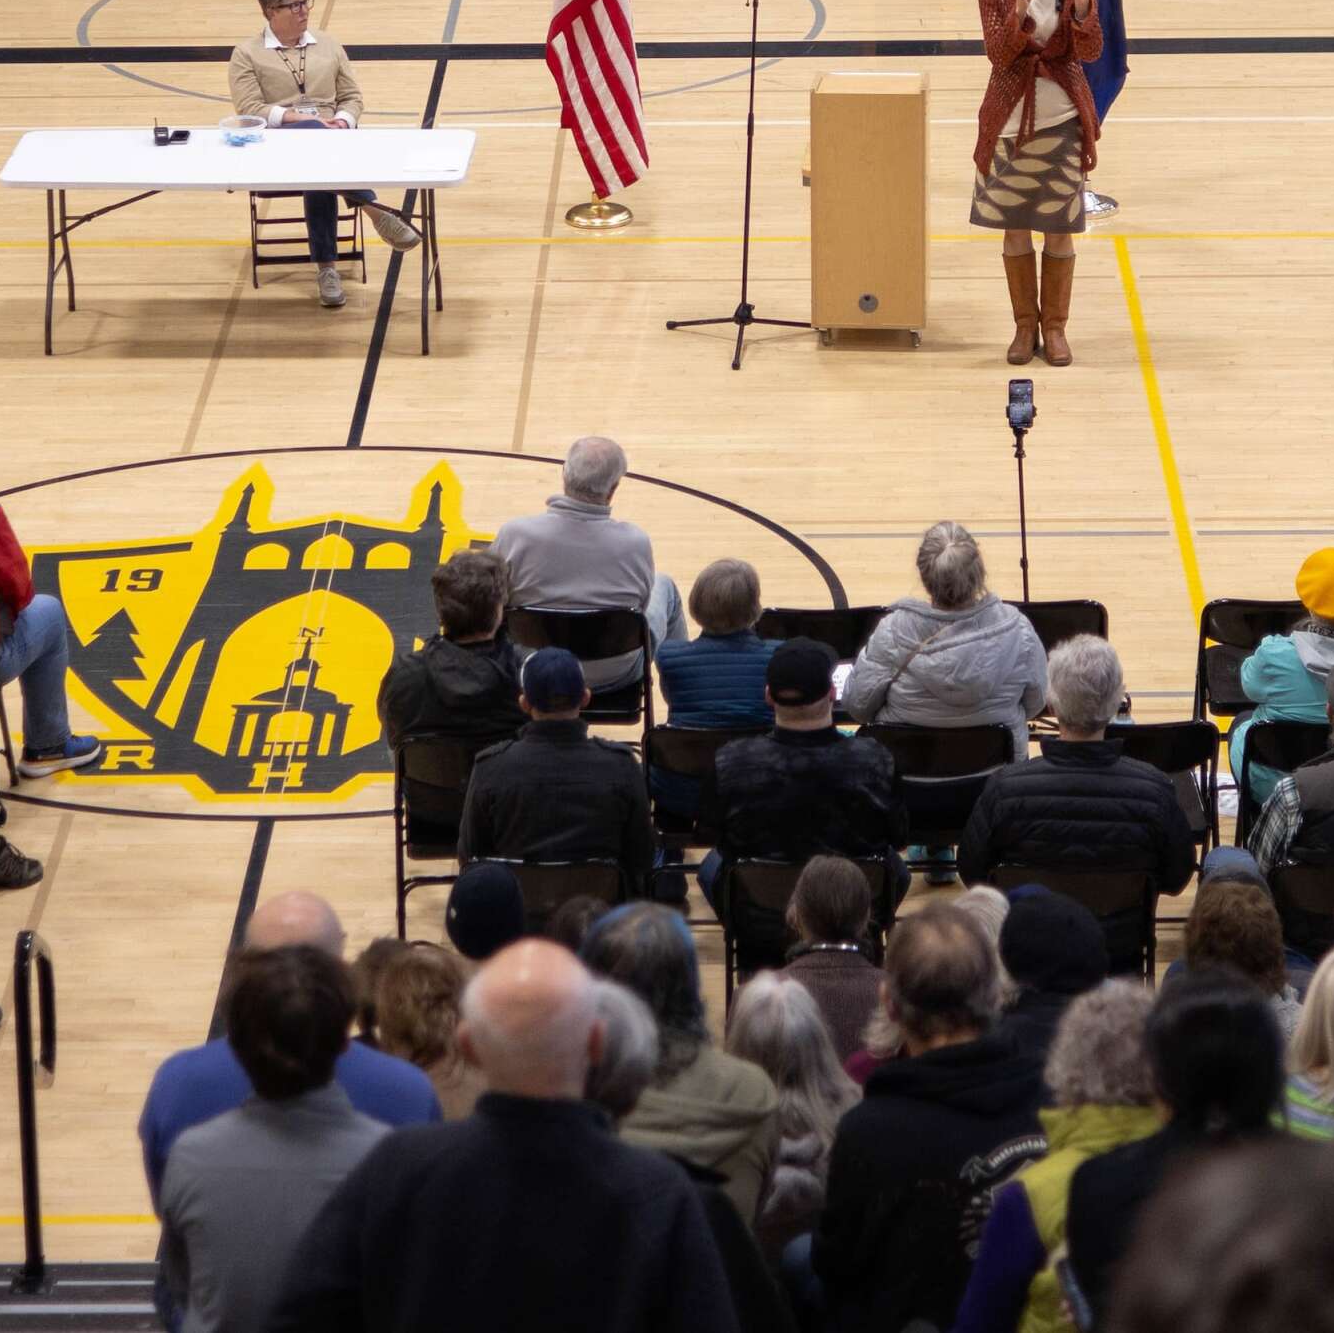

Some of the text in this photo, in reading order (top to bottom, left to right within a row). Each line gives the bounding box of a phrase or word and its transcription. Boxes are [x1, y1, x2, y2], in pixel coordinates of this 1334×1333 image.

[100, 568, 164, 592] 19
[99, 745, 307, 788] R H
